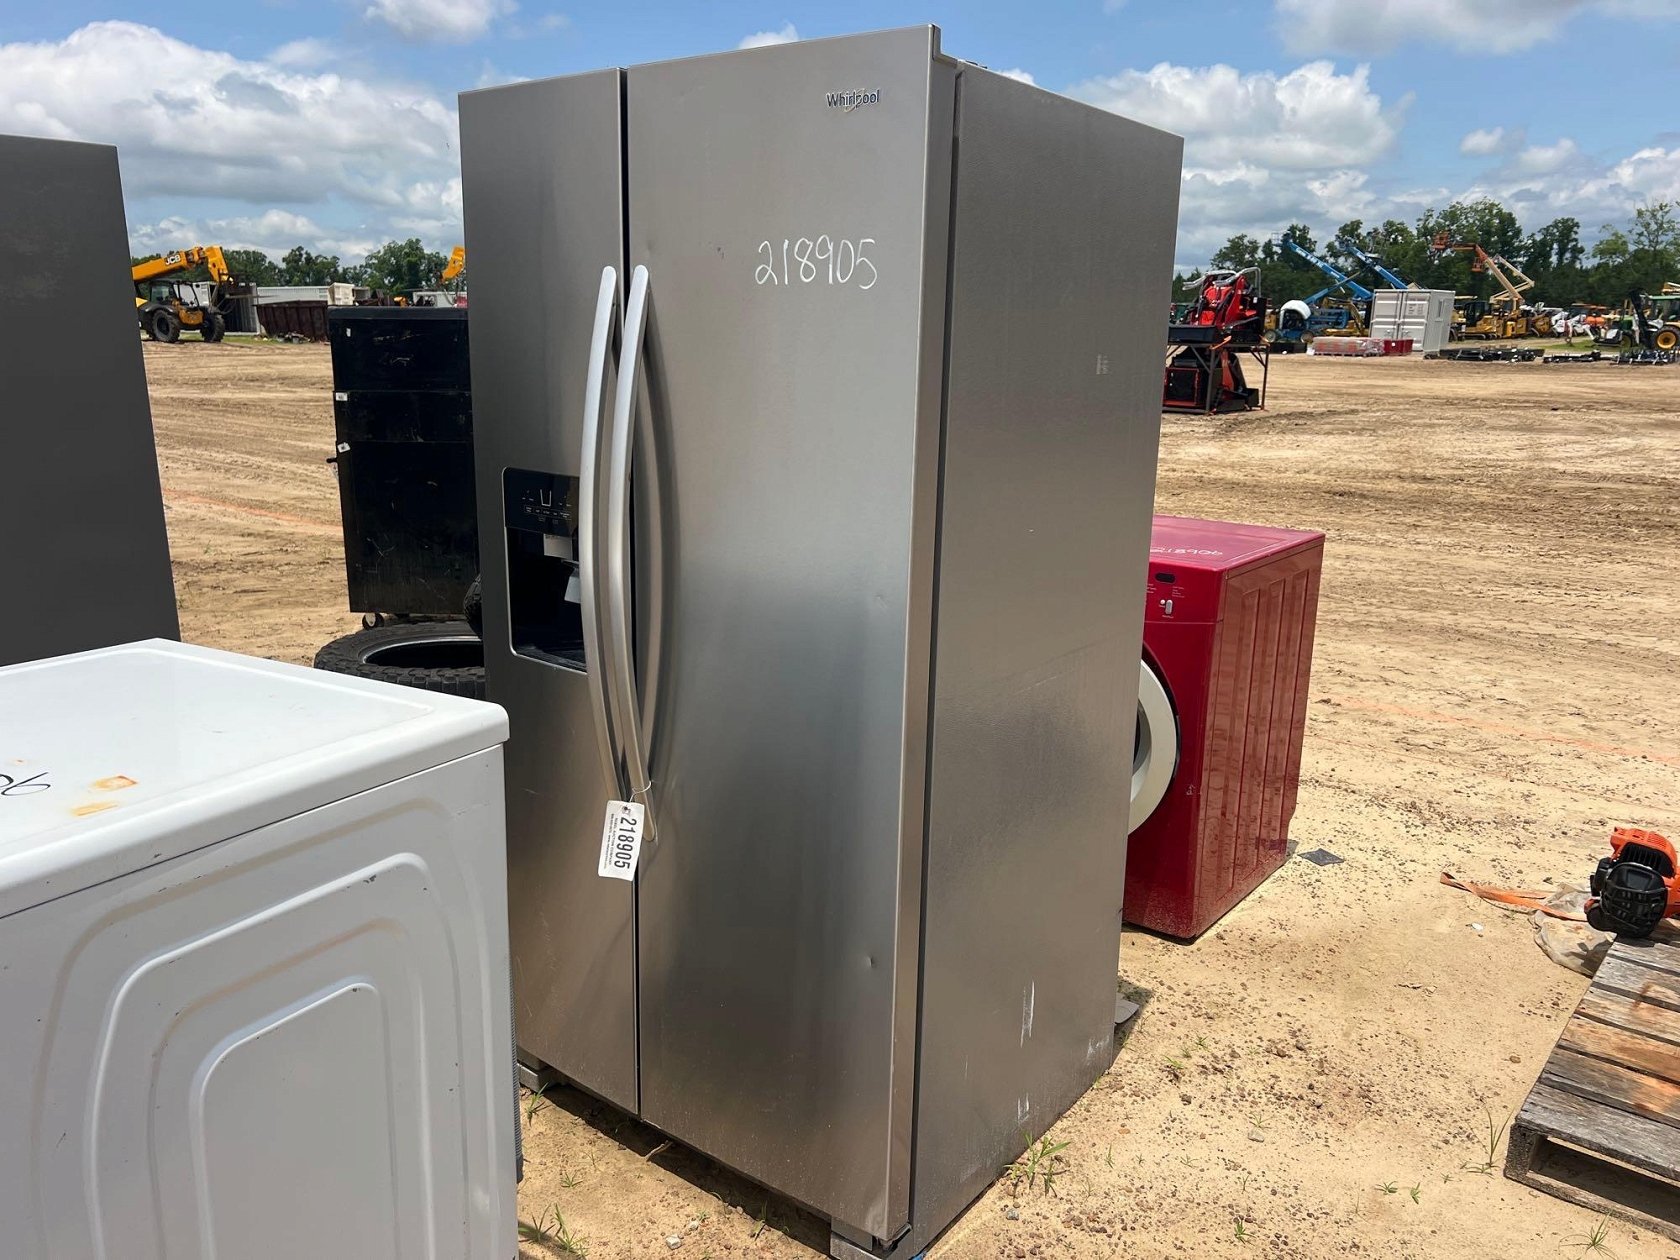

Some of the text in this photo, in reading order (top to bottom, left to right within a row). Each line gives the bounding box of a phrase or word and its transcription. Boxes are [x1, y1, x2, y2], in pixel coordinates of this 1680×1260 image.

[826, 89, 881, 112] Whirlpool
[165, 254, 180, 265] JCB
[755, 234, 877, 289] 218905
[613, 816, 637, 869] 218905
